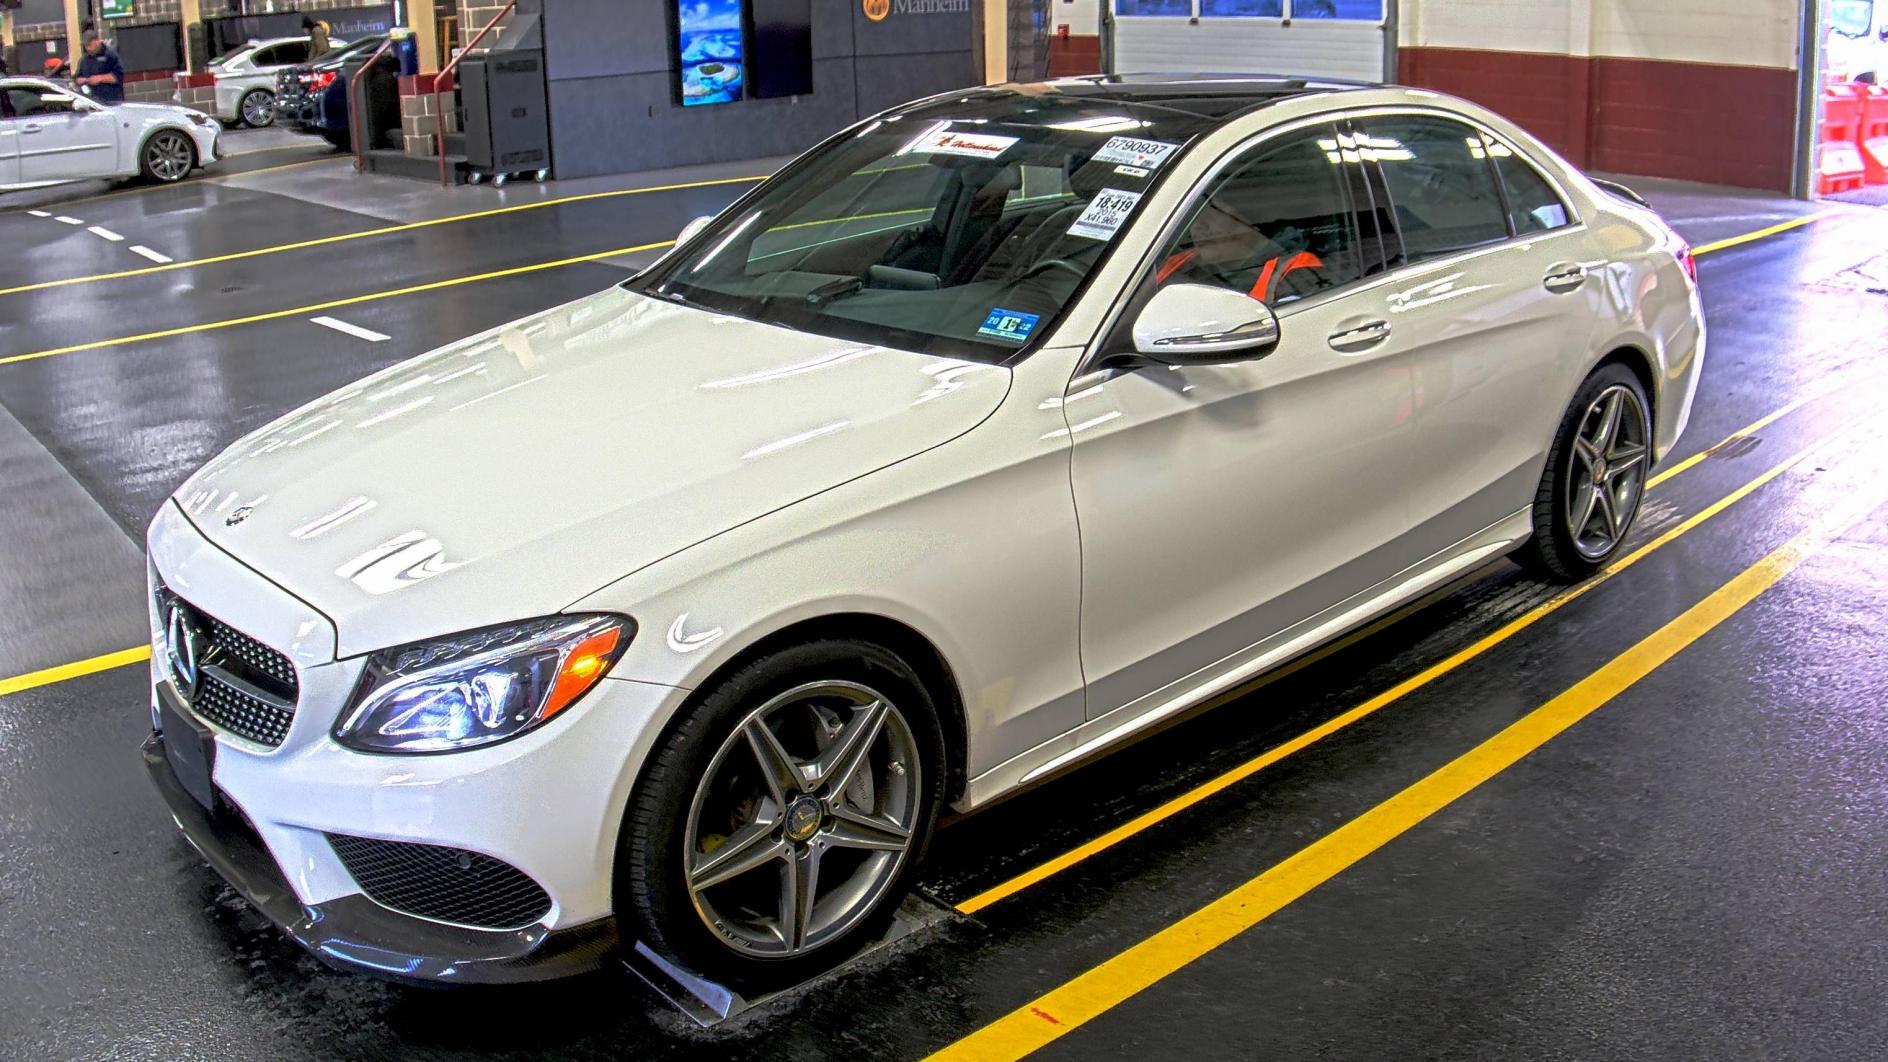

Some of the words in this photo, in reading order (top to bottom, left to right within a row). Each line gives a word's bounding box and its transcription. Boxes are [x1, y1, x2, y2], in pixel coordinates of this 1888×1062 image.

[333, 21, 384, 35] Manheim
[1106, 138, 1168, 155] 6790937
[1096, 196, 1133, 212] 18:419
[986, 316, 1001, 325] 20
